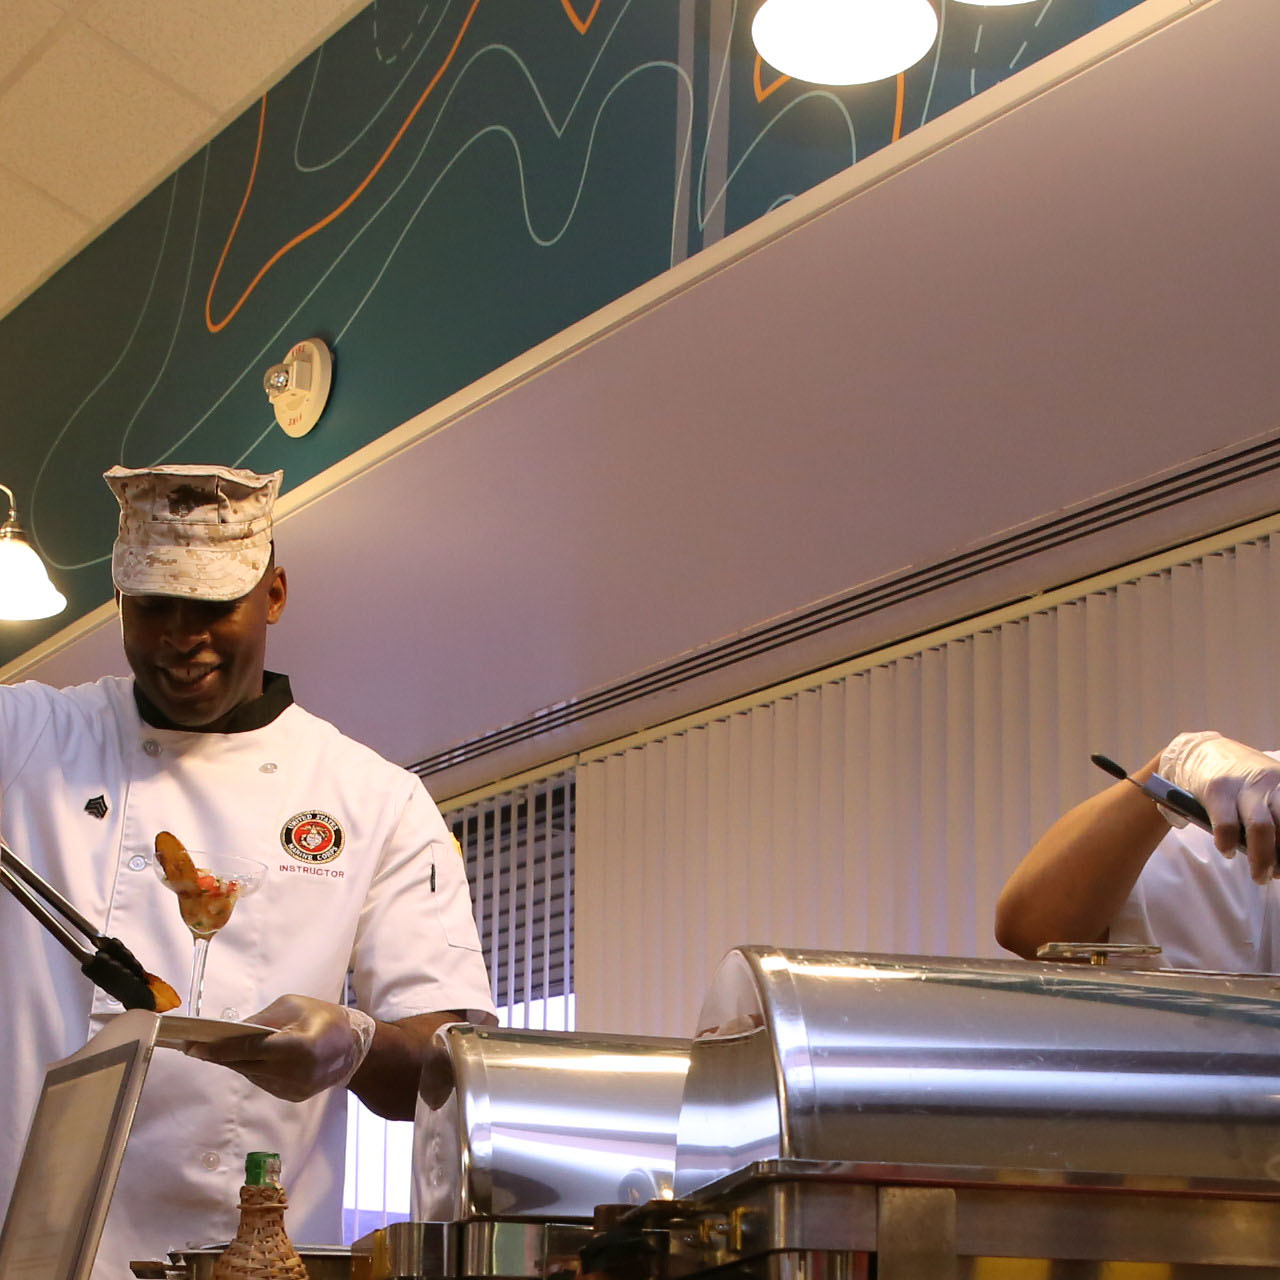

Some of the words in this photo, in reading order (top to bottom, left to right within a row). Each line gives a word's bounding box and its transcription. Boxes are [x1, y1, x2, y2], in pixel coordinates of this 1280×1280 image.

[287, 814, 313, 829] UNITED
[315, 814, 339, 831] STATES
[288, 843, 313, 860] MARINE
[316, 846, 338, 860] CORPS
[279, 865, 344, 878] INSTRUCTOR
